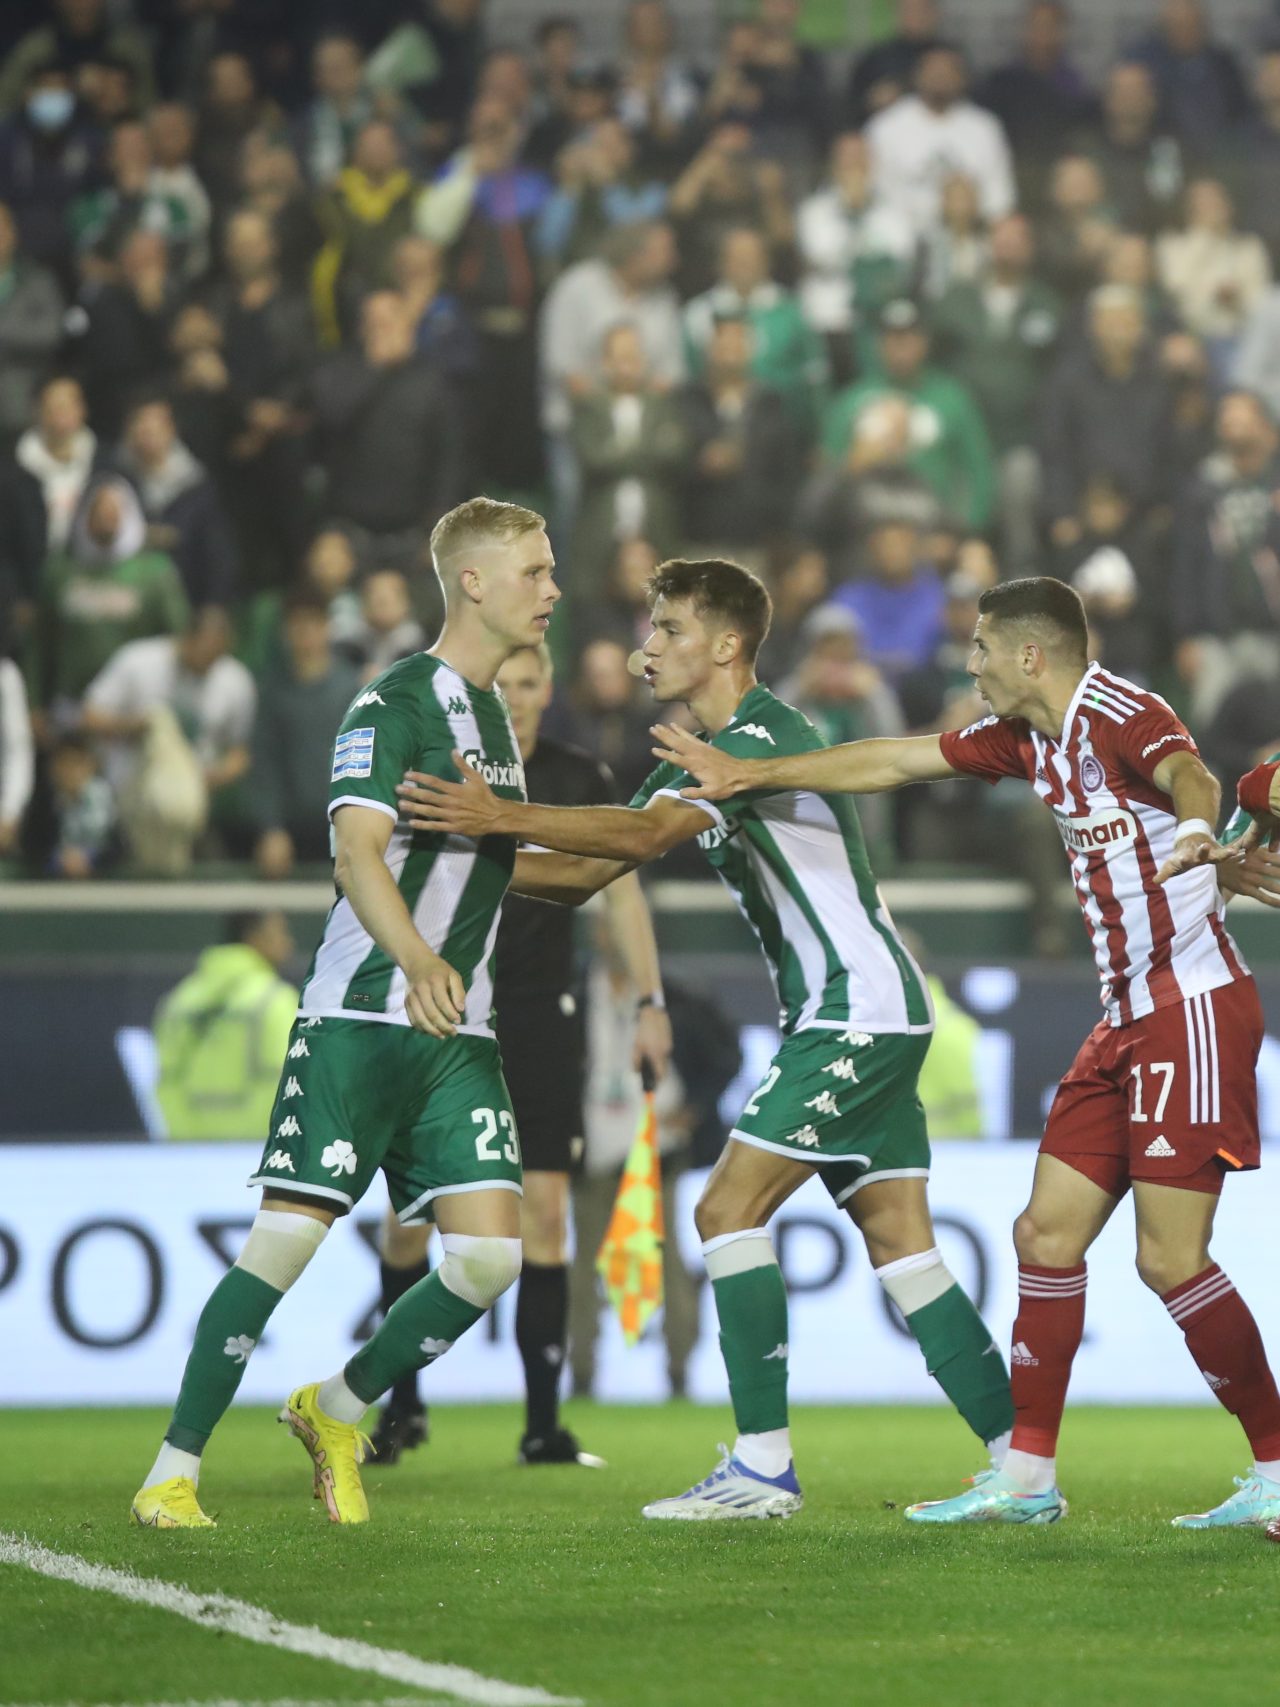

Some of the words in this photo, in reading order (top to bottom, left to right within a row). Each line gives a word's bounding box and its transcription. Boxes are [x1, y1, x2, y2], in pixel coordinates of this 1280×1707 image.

[1131, 1062, 1175, 1123] 17
[471, 1107, 520, 1165] 23
[1145, 1148, 1176, 1157] adidas
